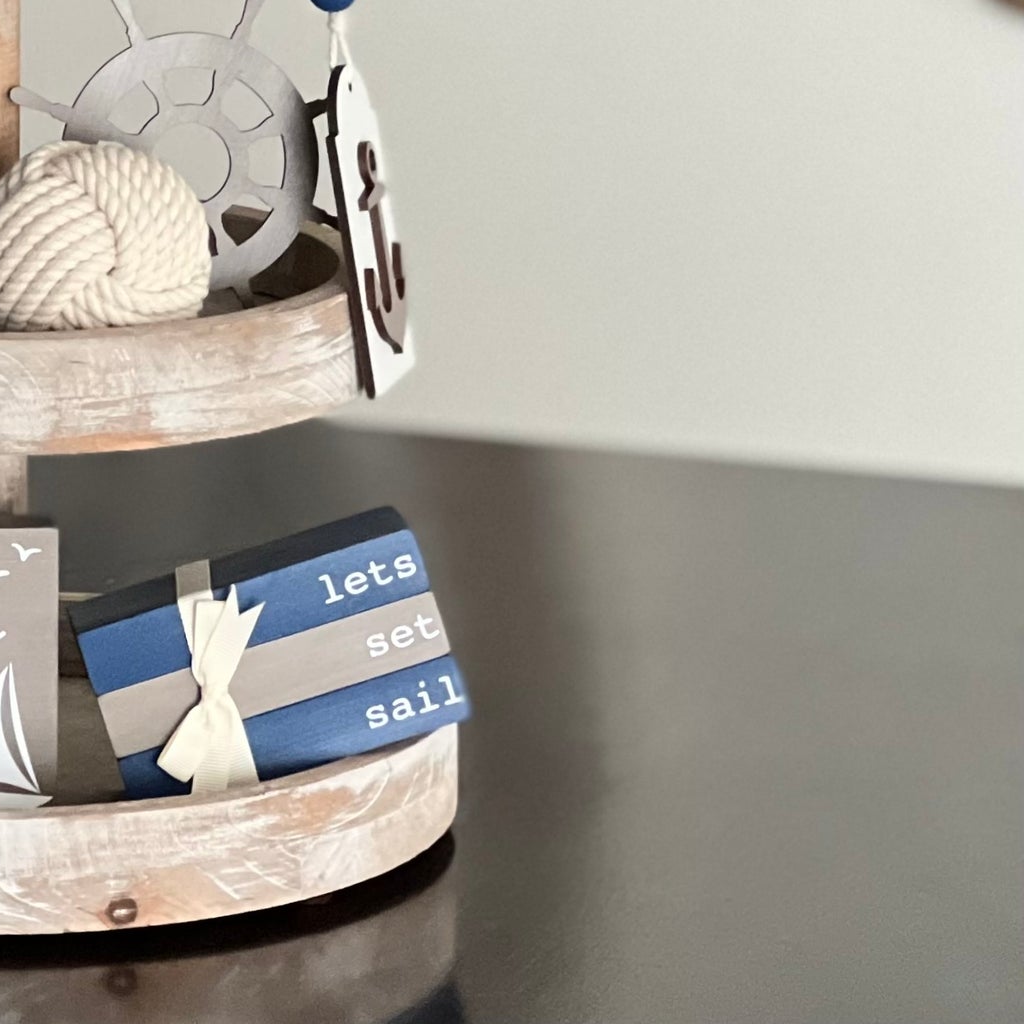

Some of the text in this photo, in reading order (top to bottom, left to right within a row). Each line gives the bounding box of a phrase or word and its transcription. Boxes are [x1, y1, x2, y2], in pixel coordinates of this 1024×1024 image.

[318, 553, 417, 604] lets
[366, 614, 440, 658] set
[365, 675, 465, 730] sail
